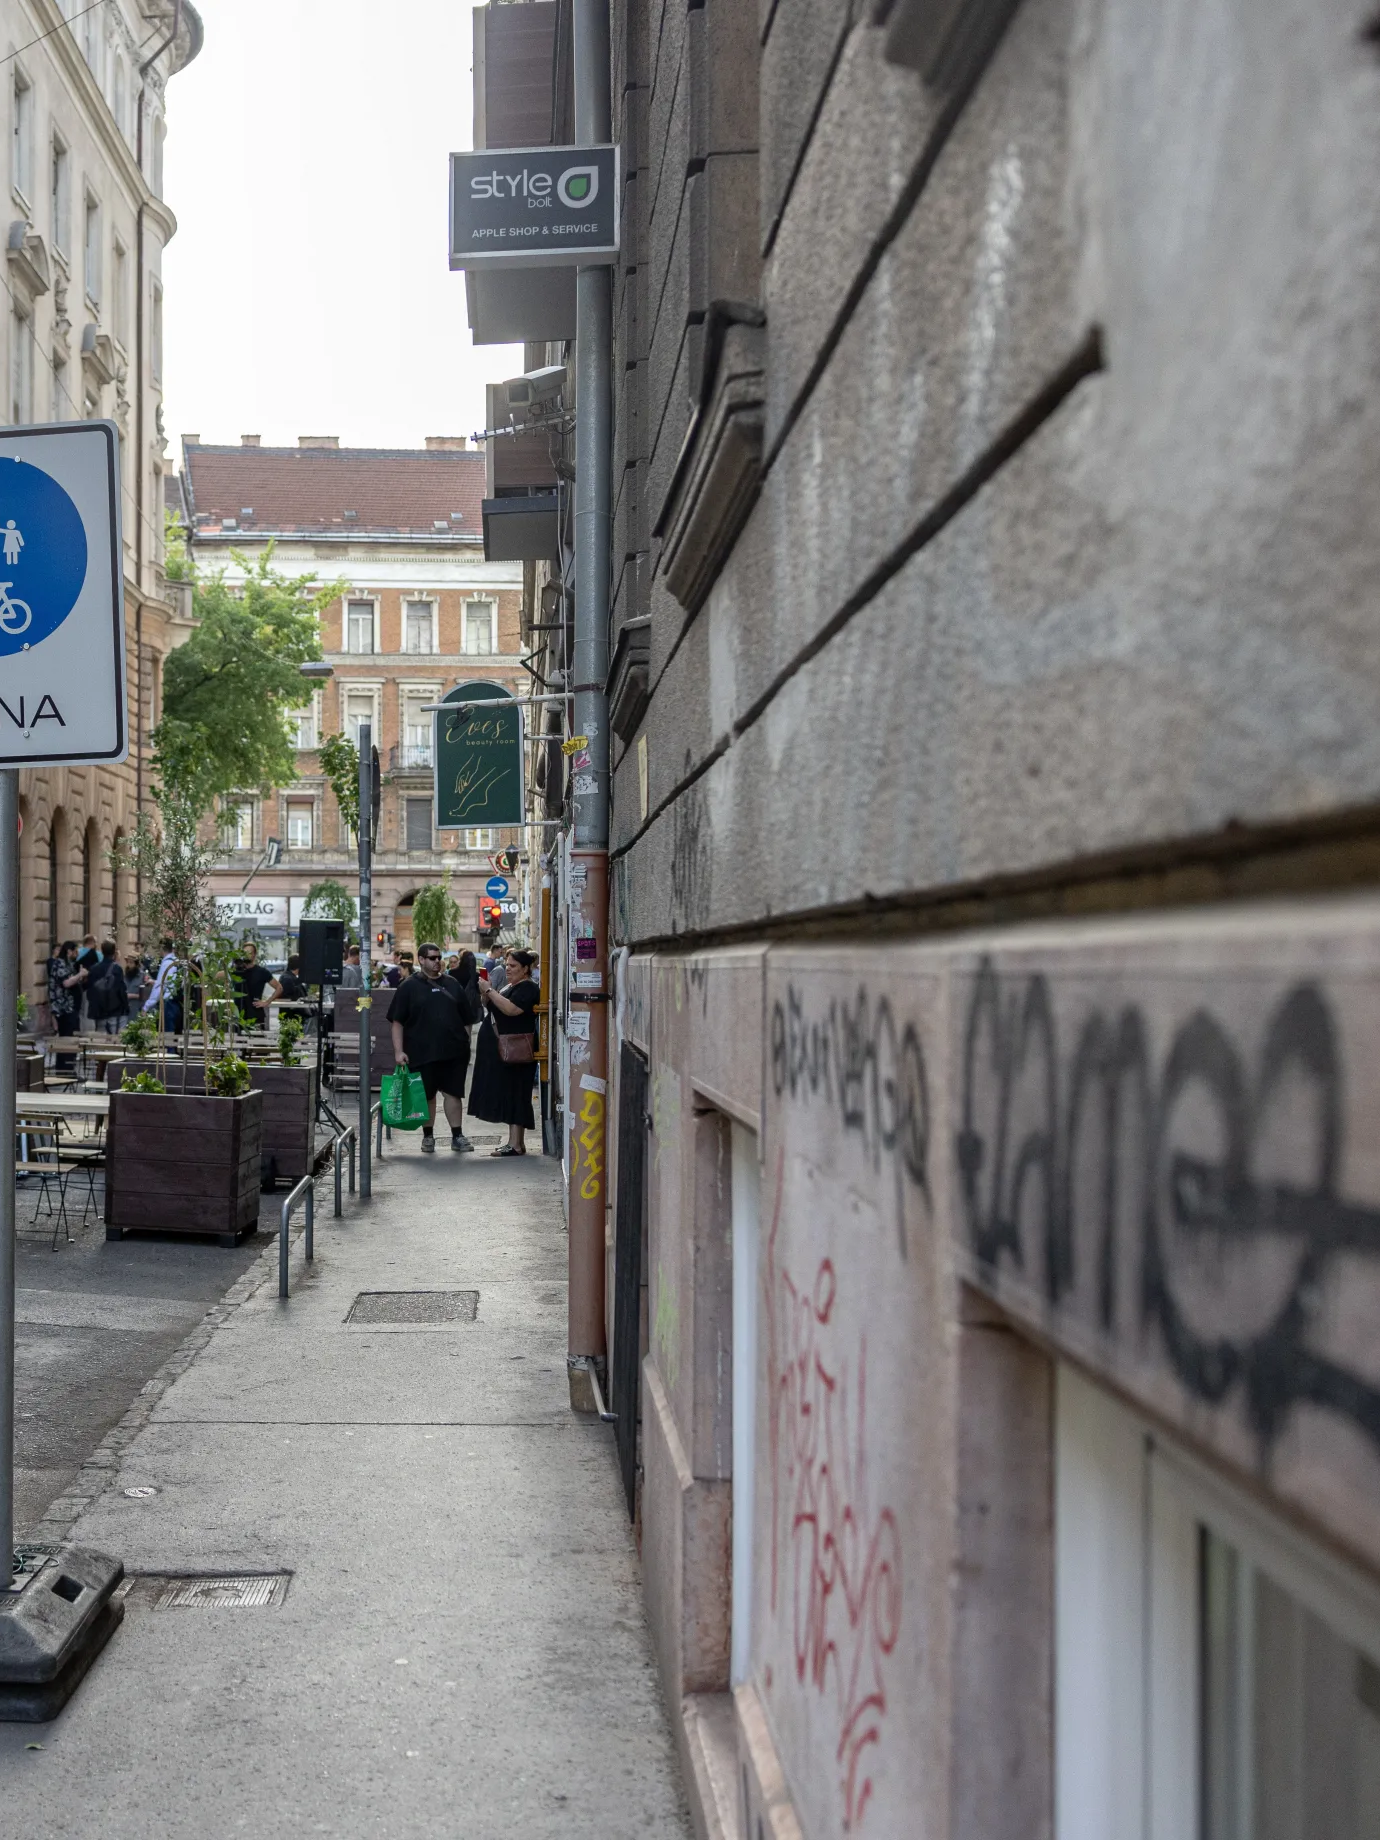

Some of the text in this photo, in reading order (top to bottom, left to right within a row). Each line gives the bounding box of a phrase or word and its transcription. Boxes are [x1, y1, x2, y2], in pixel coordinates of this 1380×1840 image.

[470, 168, 553, 199] style
[527, 196, 553, 209] bolt
[471, 223, 599, 238] APPLE SHOP & SERVICE
